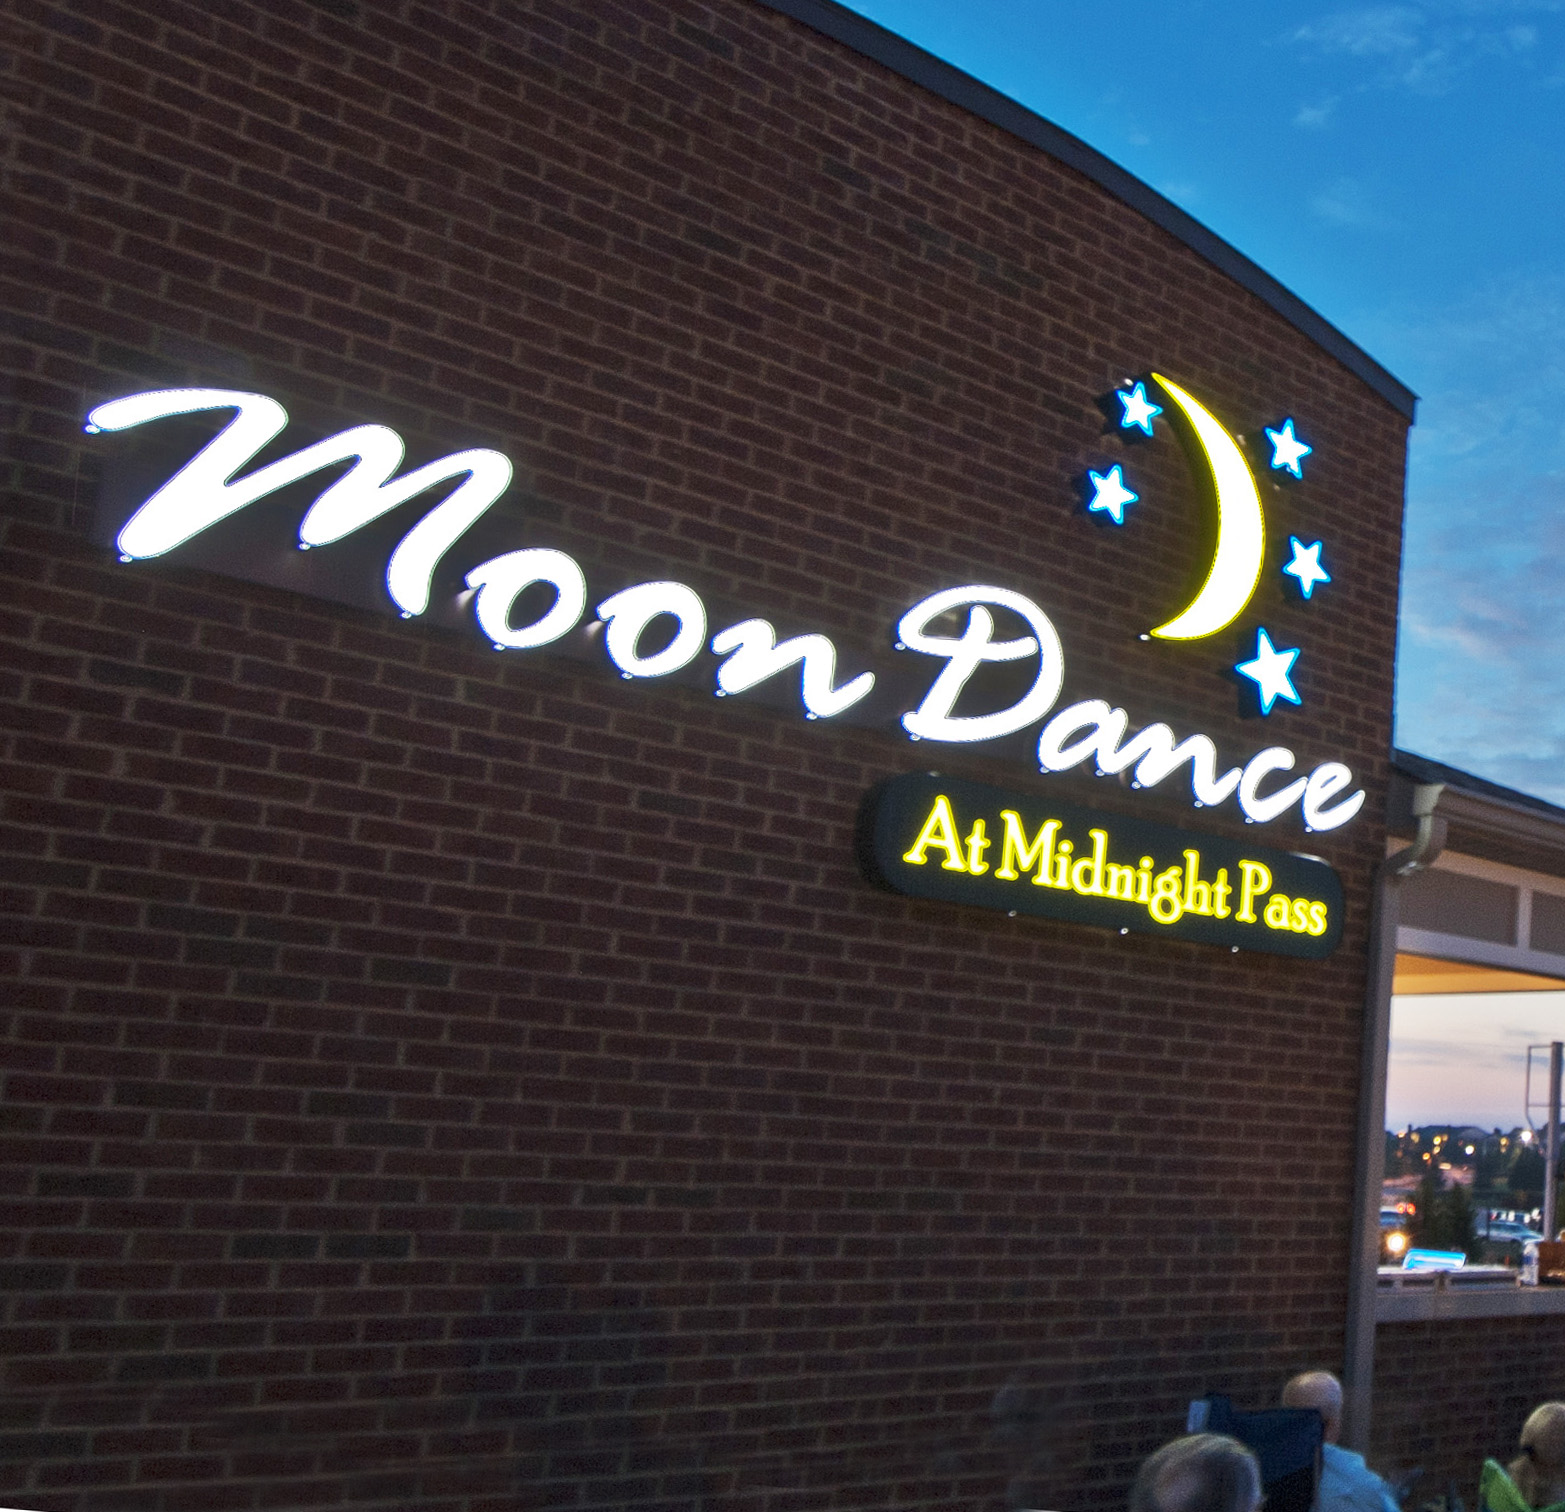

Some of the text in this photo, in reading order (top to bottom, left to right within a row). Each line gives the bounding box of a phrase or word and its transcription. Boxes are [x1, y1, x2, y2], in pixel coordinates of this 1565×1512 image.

[87, 387, 1366, 832] Moon Dance
[903, 795, 1328, 937] At Midnight Pass
